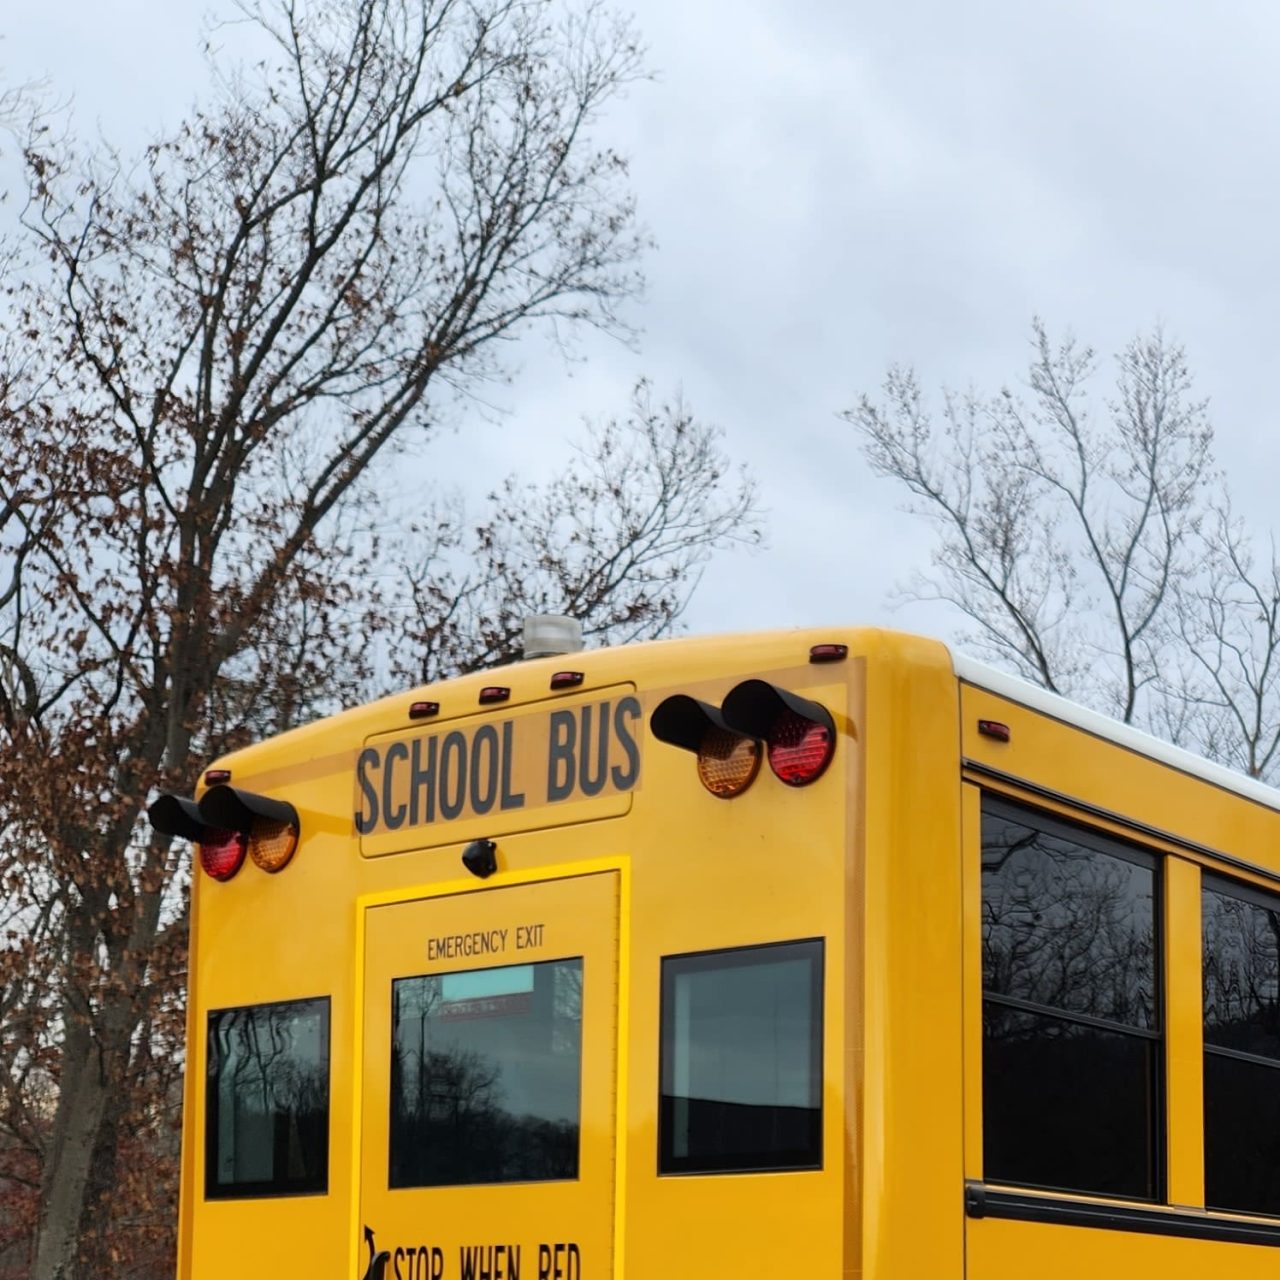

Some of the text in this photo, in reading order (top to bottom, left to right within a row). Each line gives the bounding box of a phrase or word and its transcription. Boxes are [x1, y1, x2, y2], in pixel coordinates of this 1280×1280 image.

[355, 697, 641, 834] SCHOOL BUS
[428, 924, 545, 961] EMERGENCY EXIT
